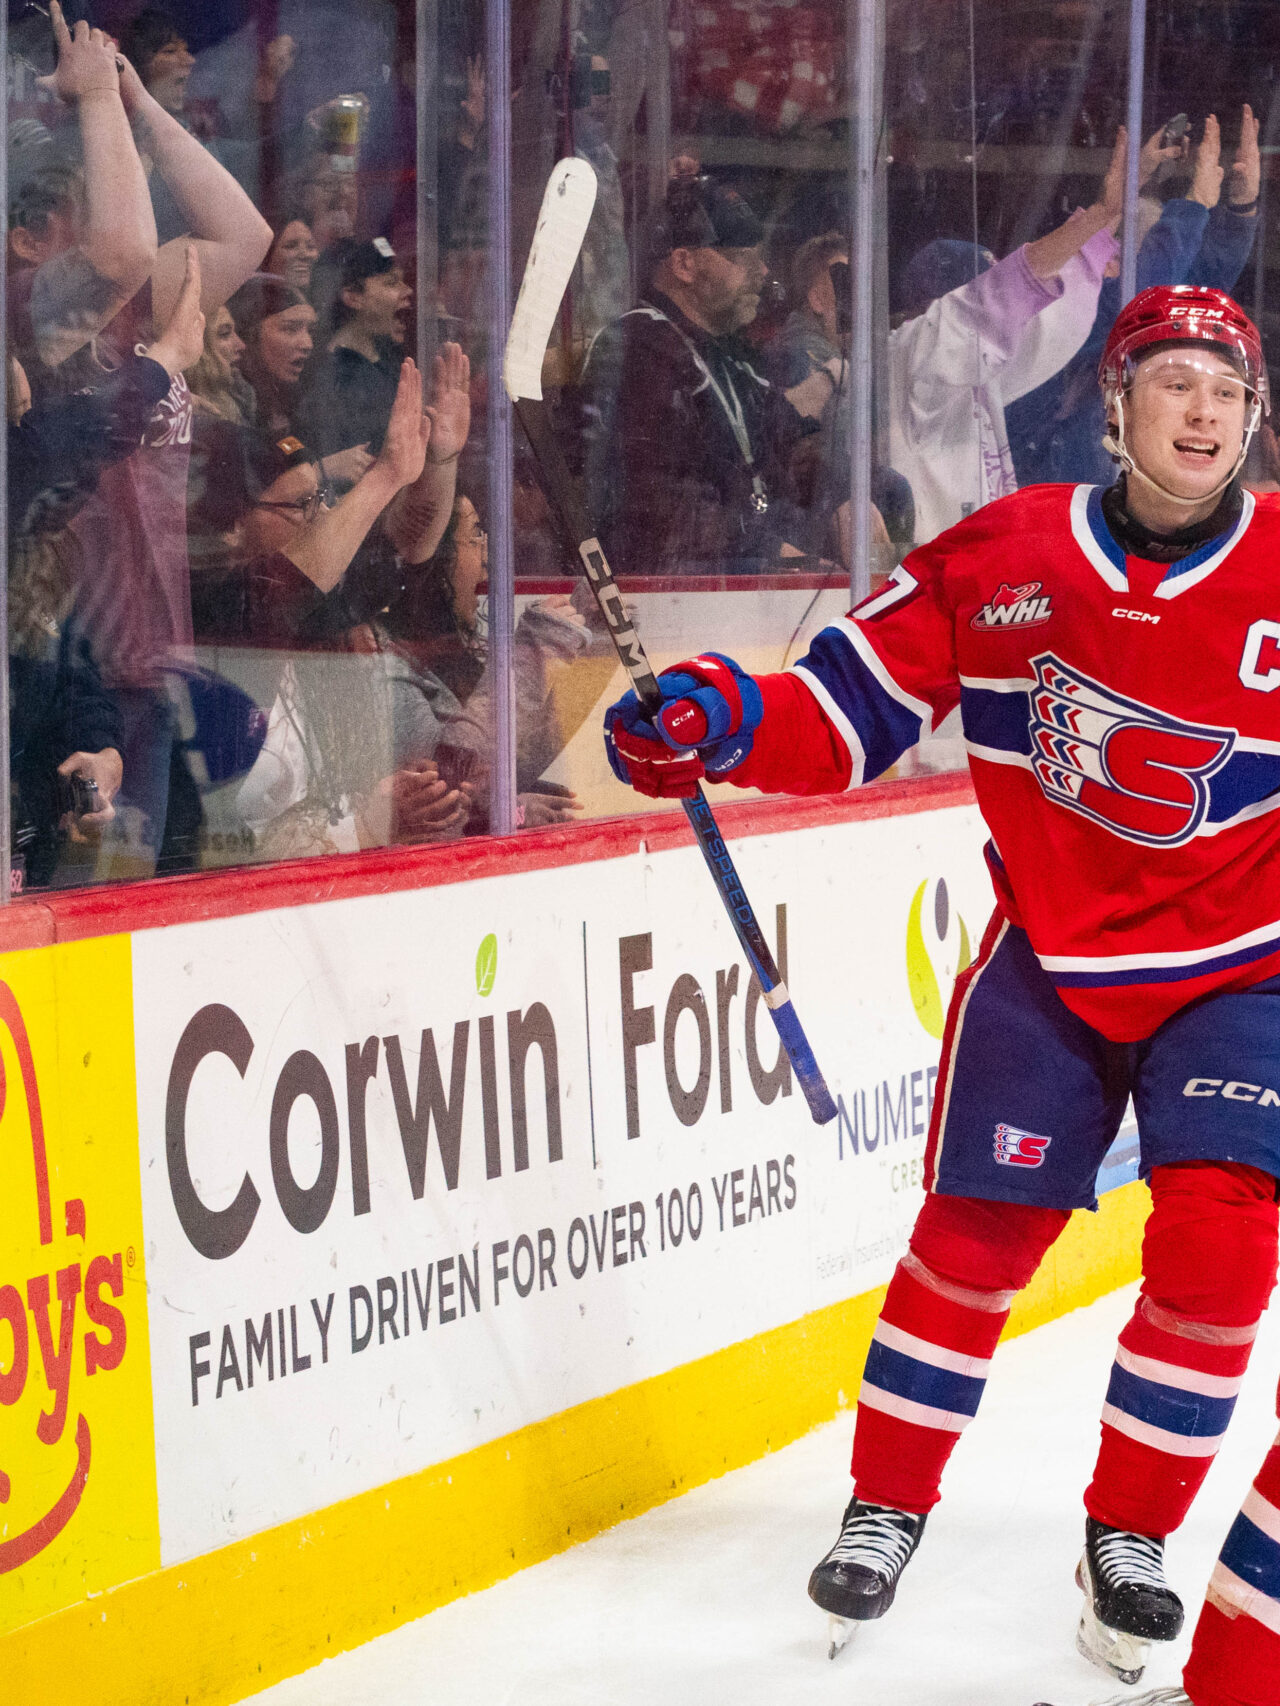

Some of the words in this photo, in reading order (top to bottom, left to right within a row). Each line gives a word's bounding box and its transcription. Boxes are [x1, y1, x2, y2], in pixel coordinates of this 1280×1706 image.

[1169, 307, 1224, 318] CCM
[579, 537, 654, 680] CCM
[983, 596, 1053, 626] WHL
[1112, 607, 1161, 625] CCM
[672, 709, 695, 727] CCM
[690, 792, 754, 924] JETSPEED
[165, 933, 563, 1260] Corwin
[617, 903, 794, 1141] Ford
[190, 1295, 335, 1407] FAMILY
[350, 1248, 482, 1345] DRIVEN
[491, 1229, 559, 1307] FOR
[567, 1209, 647, 1281] OVER
[655, 1182, 703, 1249] 100
[711, 1153, 798, 1231] YEARS
